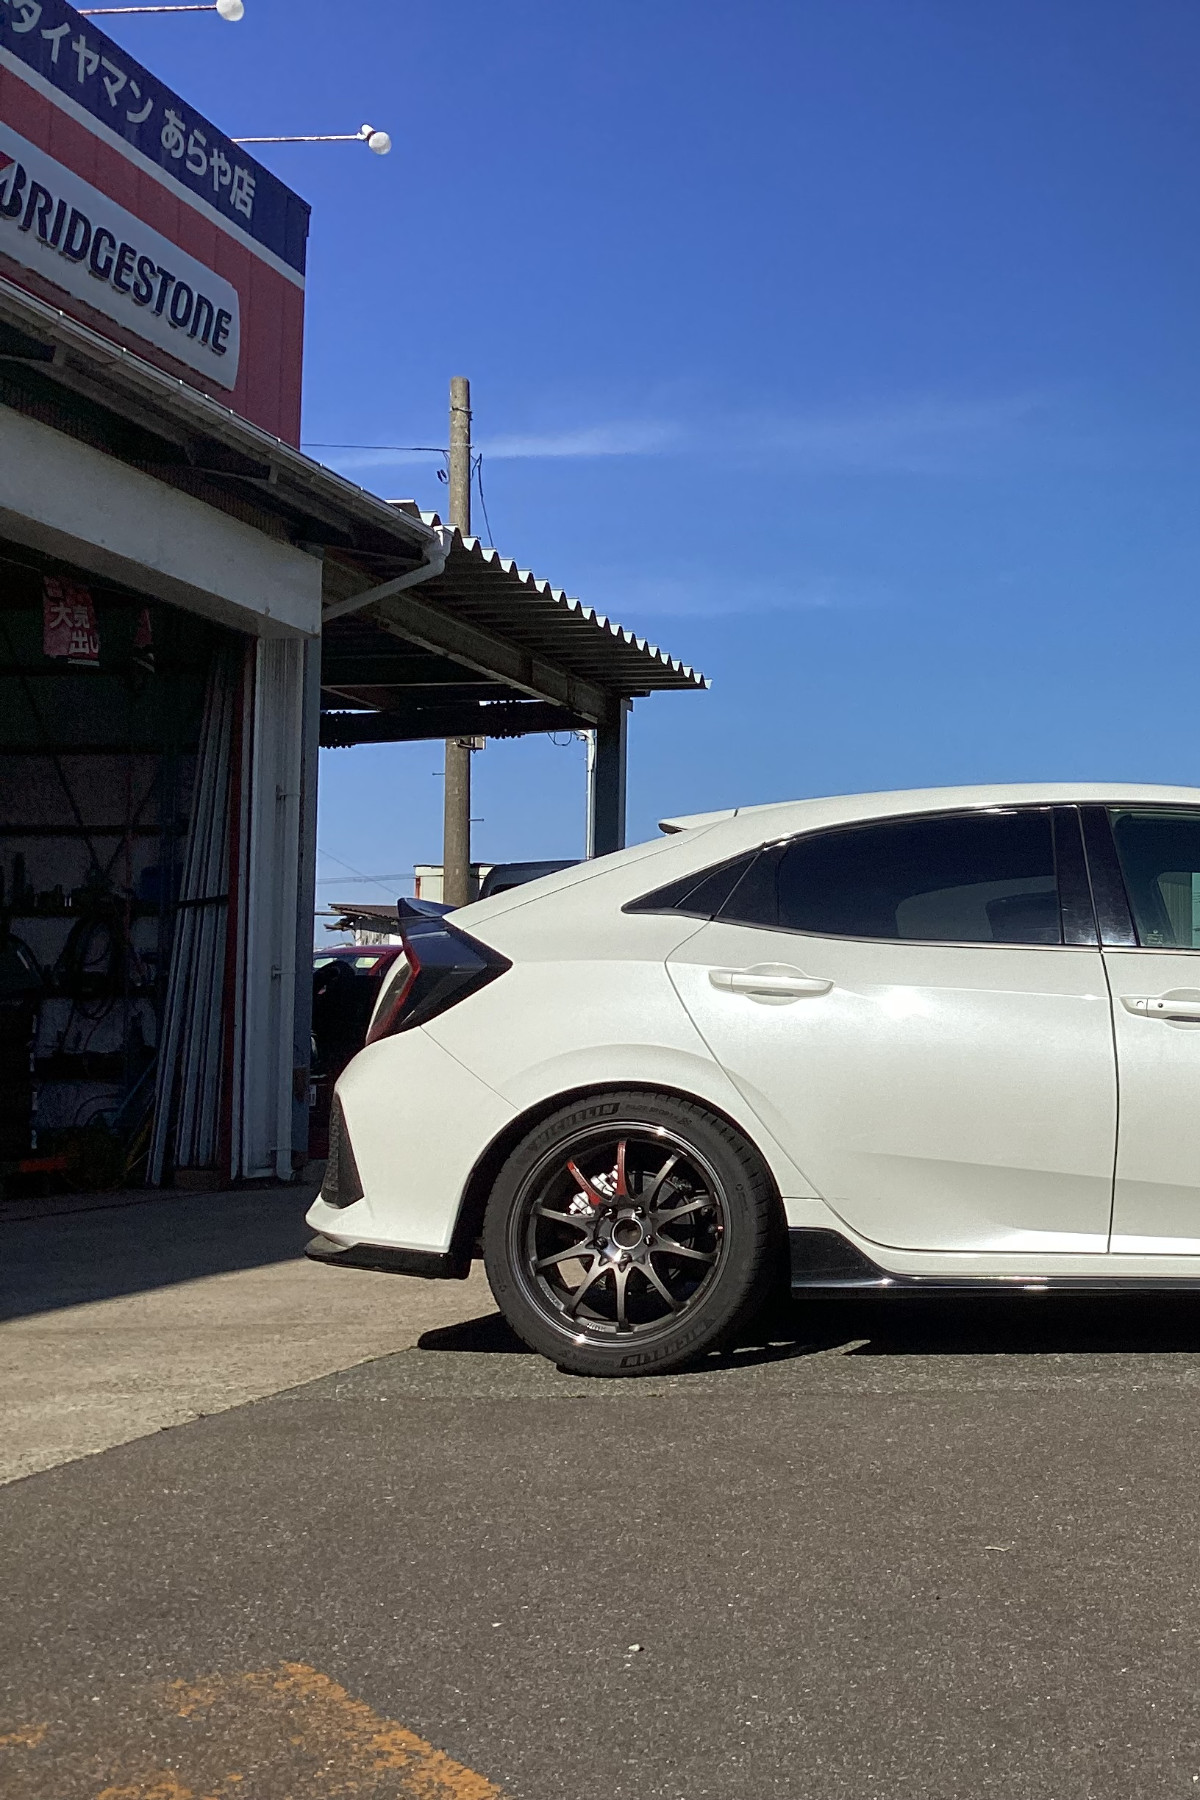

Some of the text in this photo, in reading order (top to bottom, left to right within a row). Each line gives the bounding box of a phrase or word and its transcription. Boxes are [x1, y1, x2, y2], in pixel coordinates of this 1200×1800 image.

[0, 0, 257, 220] タイヤマン あらや店
[0, 151, 233, 355] BRIDGESTONE
